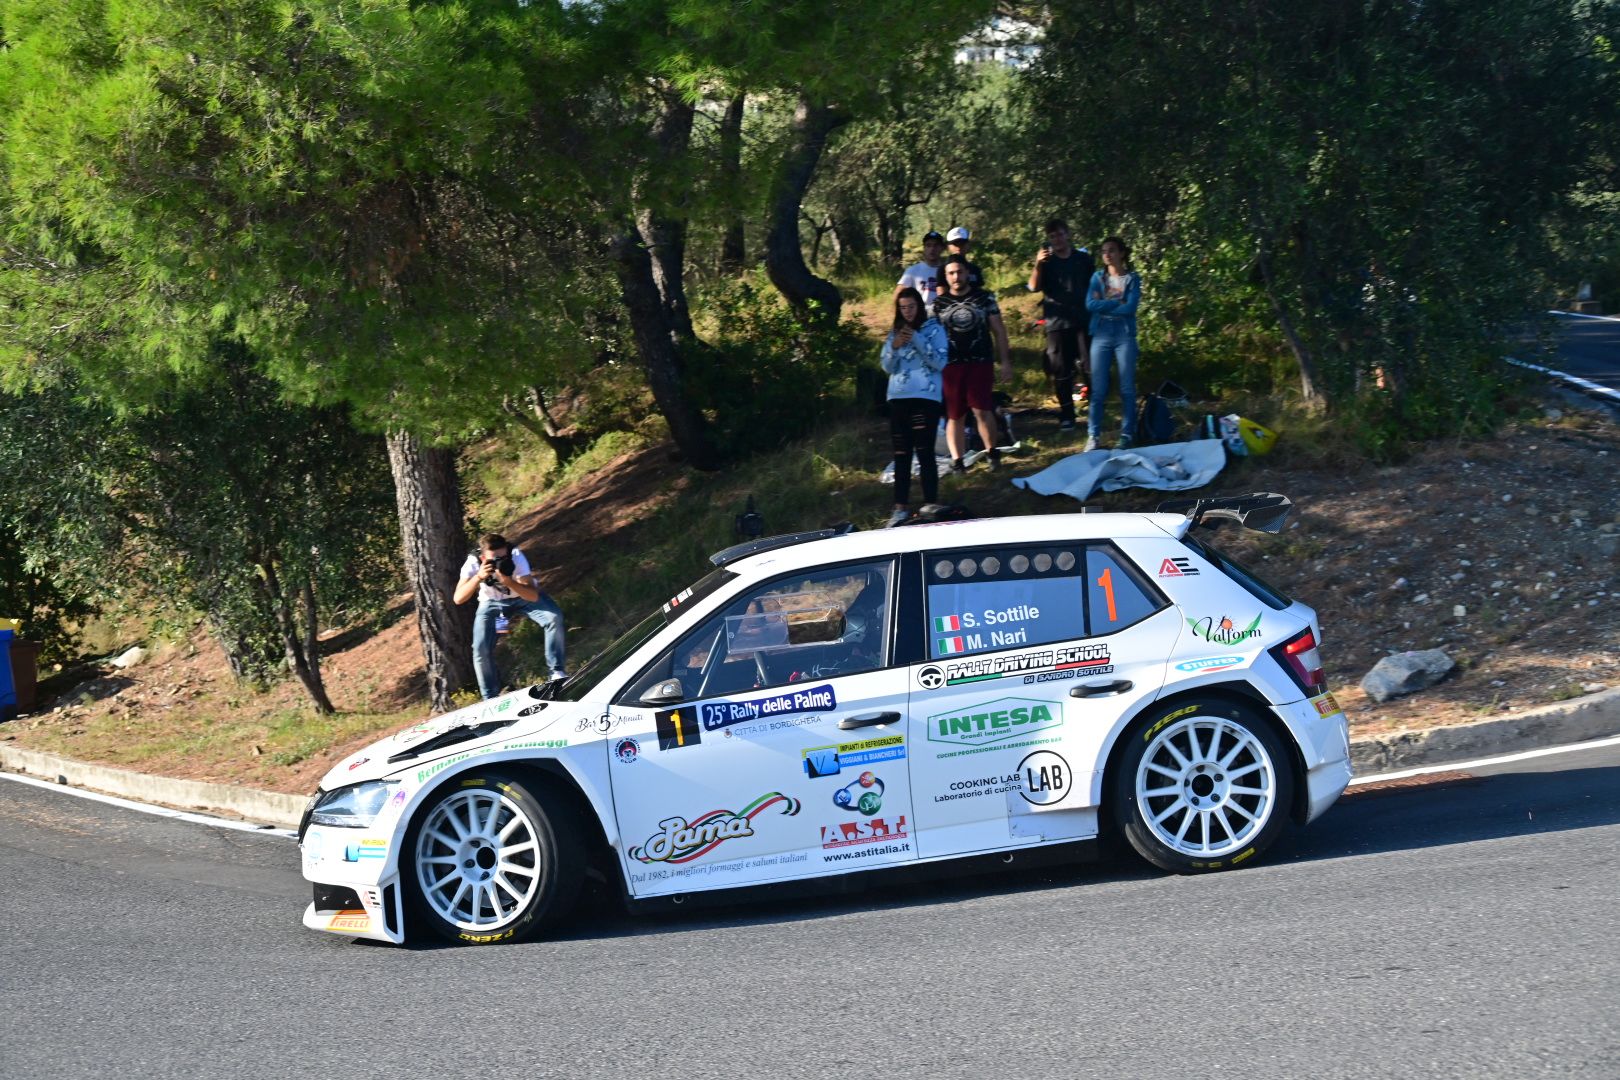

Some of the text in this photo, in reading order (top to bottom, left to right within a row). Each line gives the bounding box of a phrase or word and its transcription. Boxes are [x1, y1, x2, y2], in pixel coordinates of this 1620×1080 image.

[1098, 568, 1117, 622] 1
[963, 605, 1040, 628] S. Sottile
[967, 628, 1027, 650] M. Nari
[1192, 615, 1262, 644] Valform
[947, 644, 1111, 681] RALLY DRIVING SCHOOL
[1037, 670, 1074, 682] SANDRO
[1077, 665, 1114, 677] SOTTILE
[1184, 657, 1238, 671] STUFFER
[729, 702, 760, 720] Rally
[762, 697, 792, 713] delle
[794, 691, 832, 709] Palme
[575, 717, 596, 732] Bar
[599, 714, 611, 732] 5
[670, 709, 684, 746] 1
[770, 716, 822, 730] BORDIGHERA
[938, 705, 1053, 737] INTESA
[960, 729, 1011, 740] Grandi Impianti
[949, 773, 1021, 791] COOKING LAB
[1027, 765, 1063, 793] LAB
[934, 784, 1022, 803] Laboratorio di cucina
[823, 843, 910, 863] www.astitalia.it
[632, 874, 646, 884] Dal
[648, 870, 669, 881] 1982,
[677, 865, 707, 880] migliori
[708, 861, 744, 875] formaggi
[752, 857, 778, 868] salumi
[779, 852, 808, 863] italiani
[330, 915, 369, 928] PIRELLI
